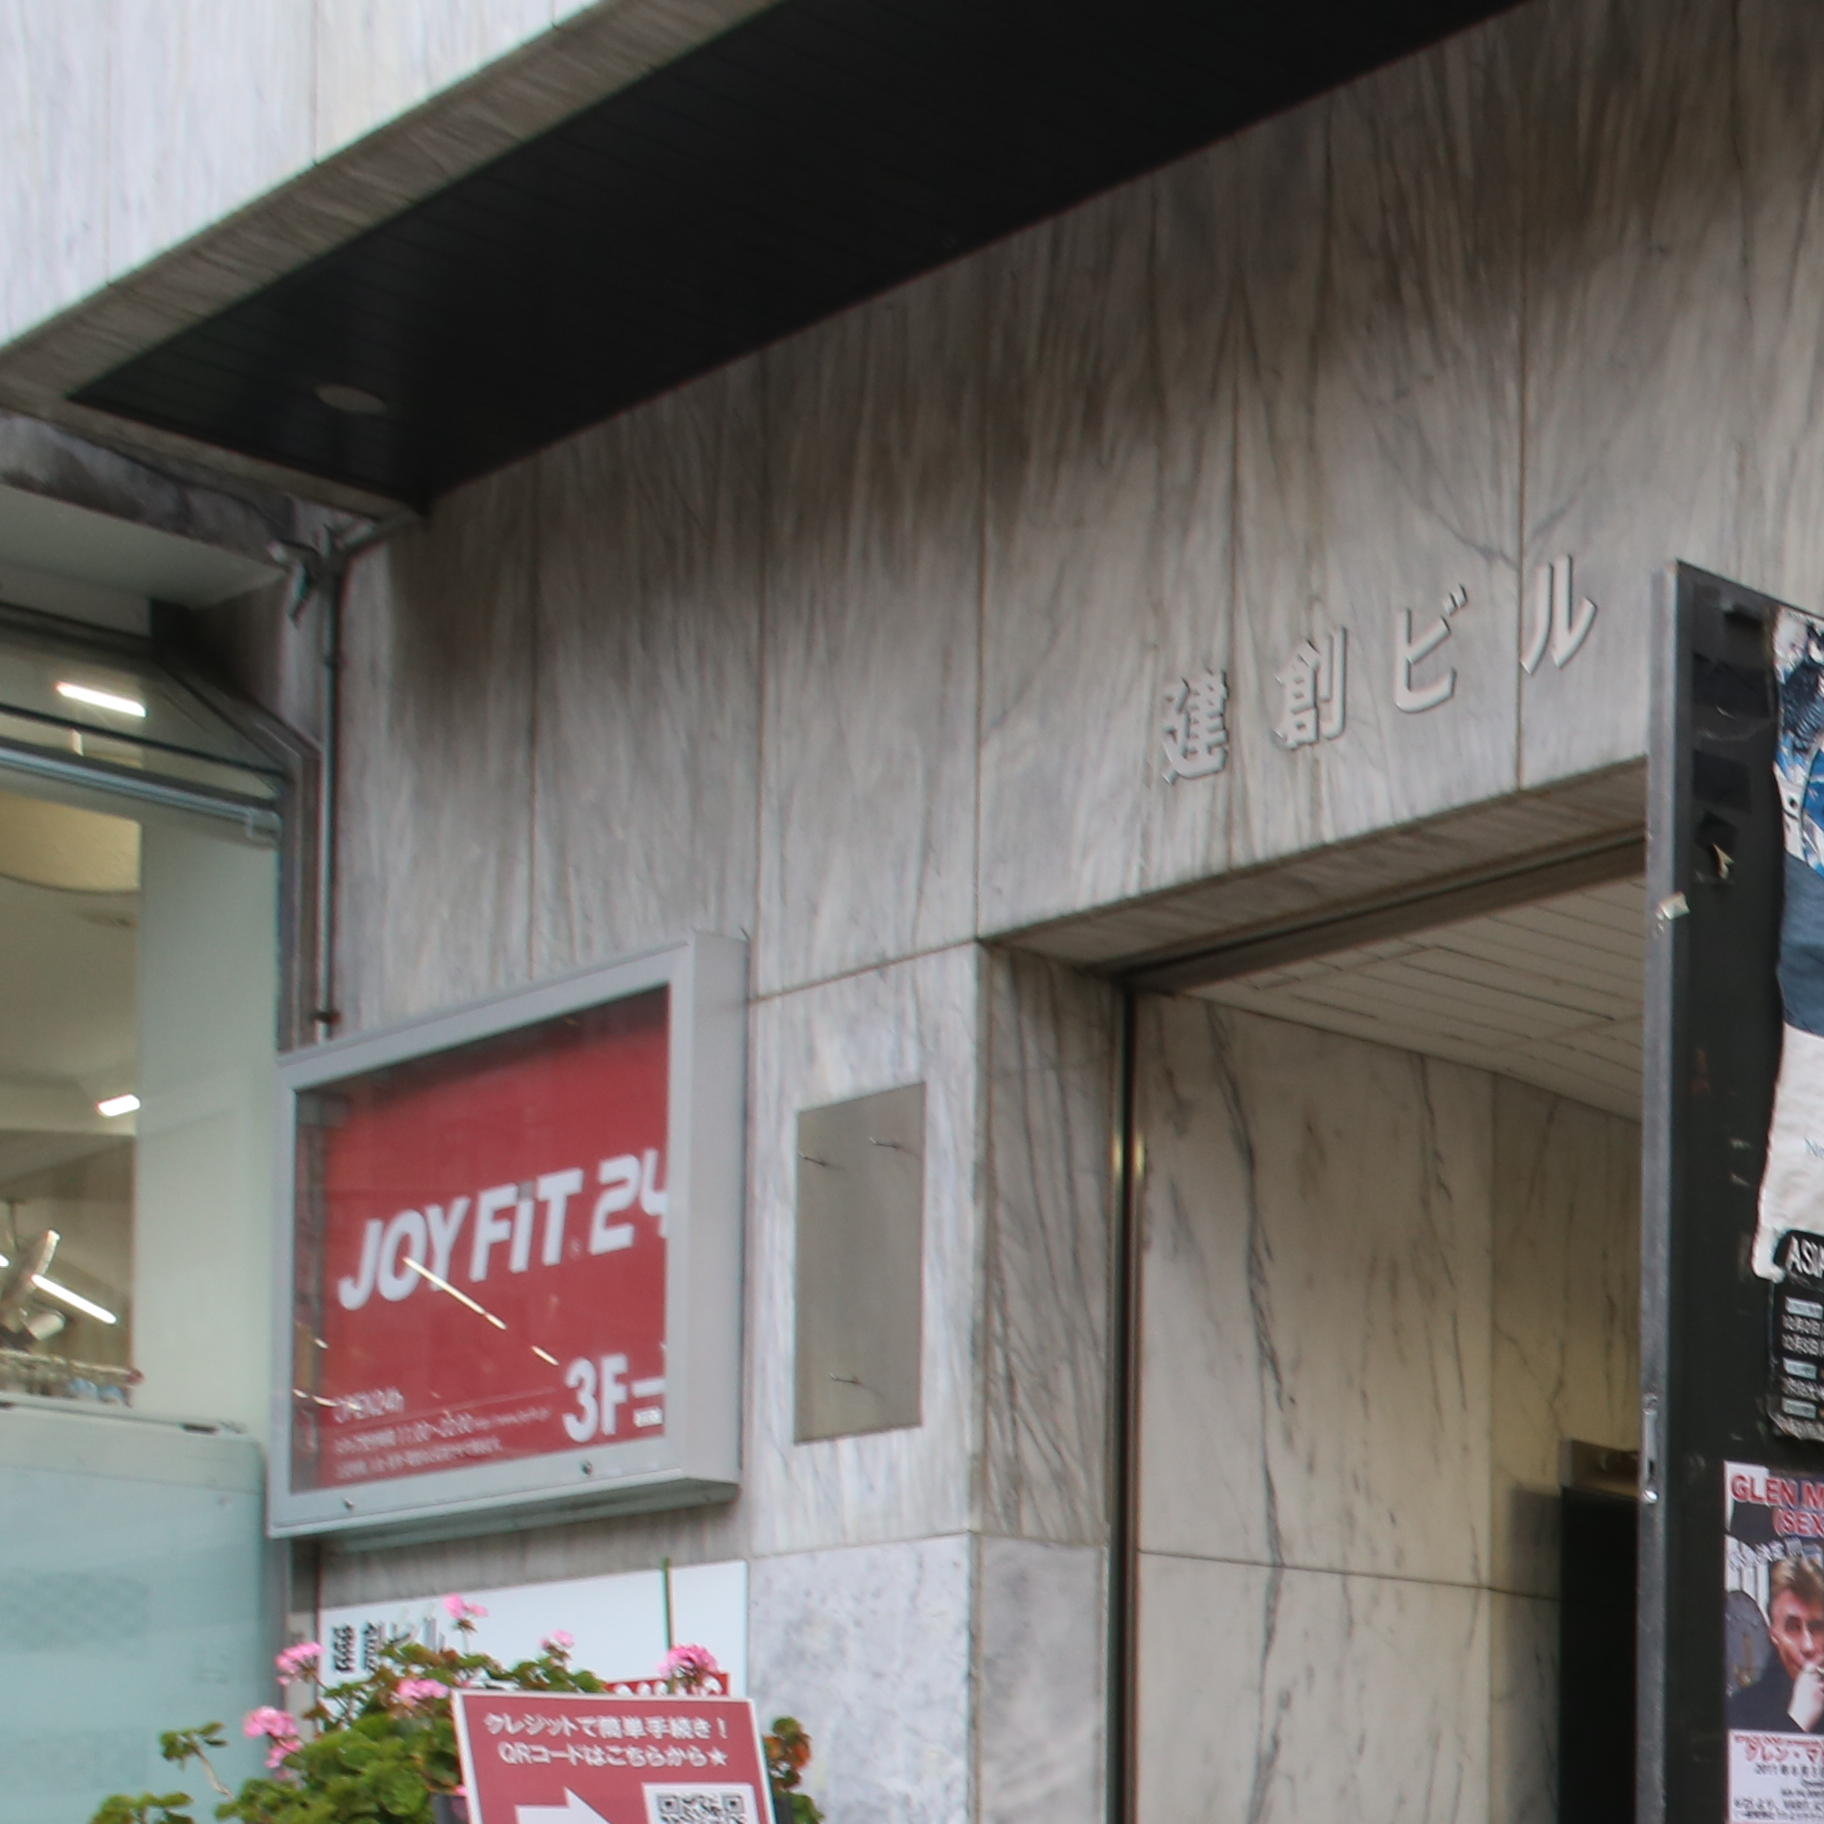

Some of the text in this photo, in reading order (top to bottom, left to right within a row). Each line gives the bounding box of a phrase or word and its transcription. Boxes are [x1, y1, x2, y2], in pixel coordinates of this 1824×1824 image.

[338, 1167, 584, 1312] JOYFIT
[561, 1354, 630, 1445] 3F
[1730, 1473, 1797, 1507] GLEN
